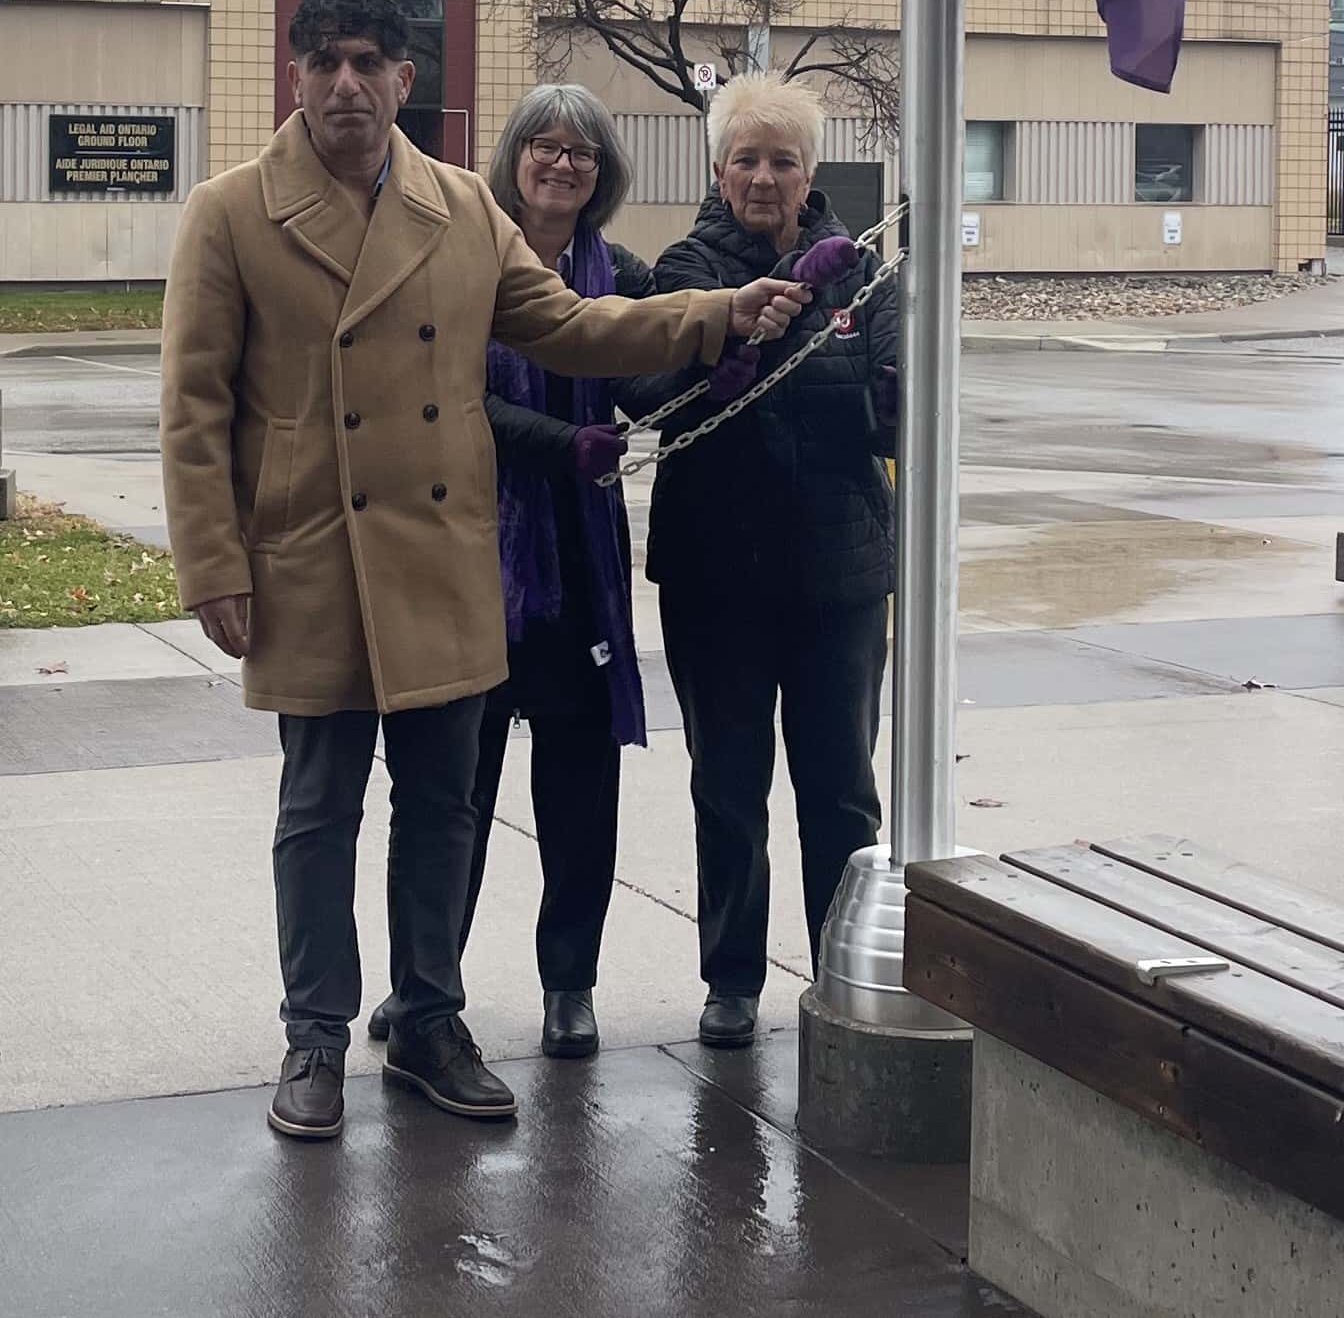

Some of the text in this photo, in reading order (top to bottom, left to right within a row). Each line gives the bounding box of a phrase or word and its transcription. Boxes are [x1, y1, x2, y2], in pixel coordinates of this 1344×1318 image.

[68, 123, 157, 135] LEGAL AID ONTARIO
[78, 135, 148, 147] GROUND FLOOR
[56, 158, 169, 170] AIDE JURIDIQUE ONTARIO
[66, 170, 108, 182] PREMIER
